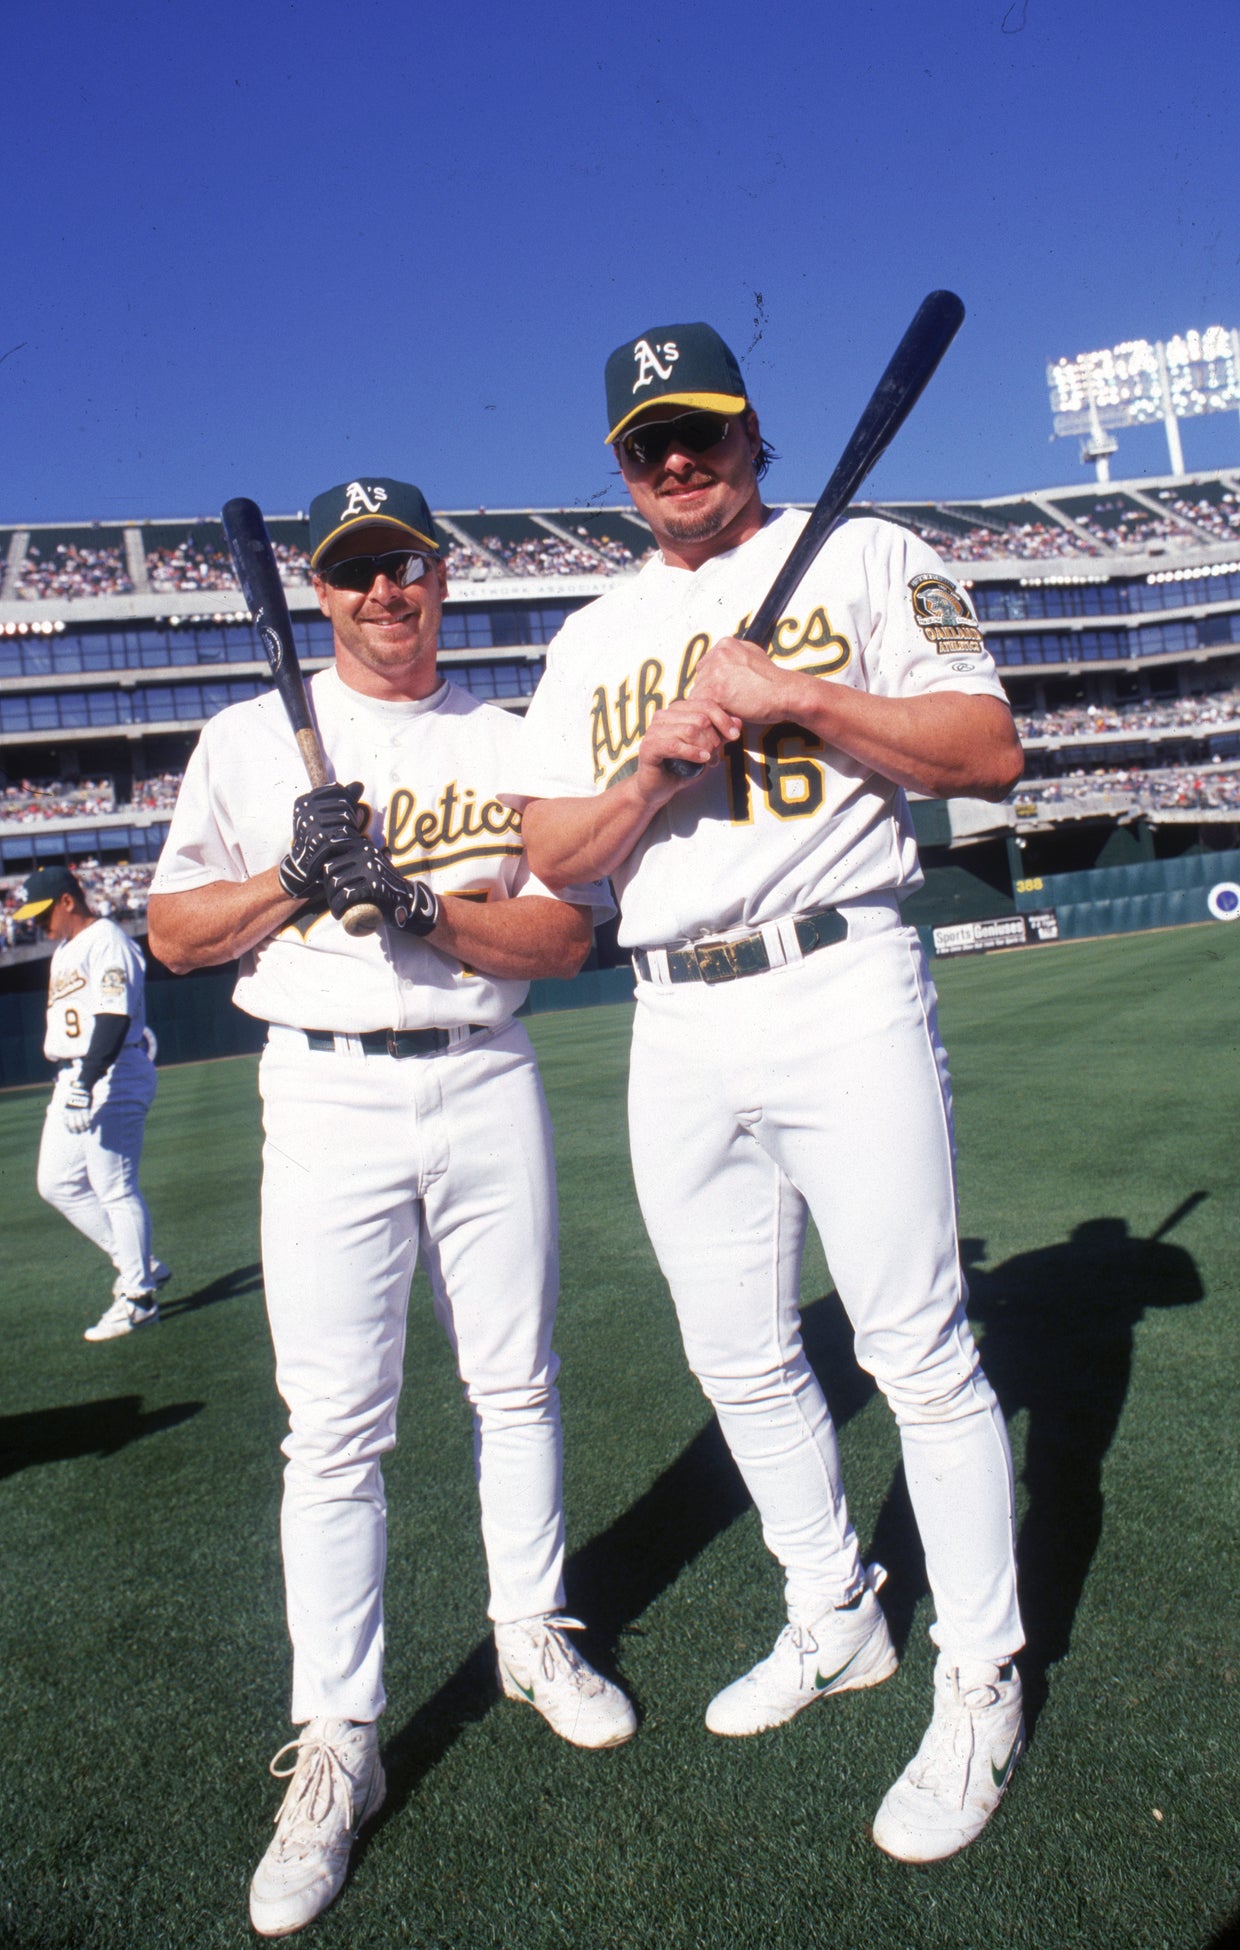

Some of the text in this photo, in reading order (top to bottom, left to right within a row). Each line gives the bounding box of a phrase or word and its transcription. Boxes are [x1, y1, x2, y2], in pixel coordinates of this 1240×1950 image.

[633, 340, 680, 394] A's
[341, 482, 387, 521] A's
[538, 583, 615, 593] ASSOCIATE
[590, 605, 852, 784] Athlcs
[722, 720, 826, 827] 16
[936, 927, 971, 944] Sports
[65, 1008, 81, 1039] 9
